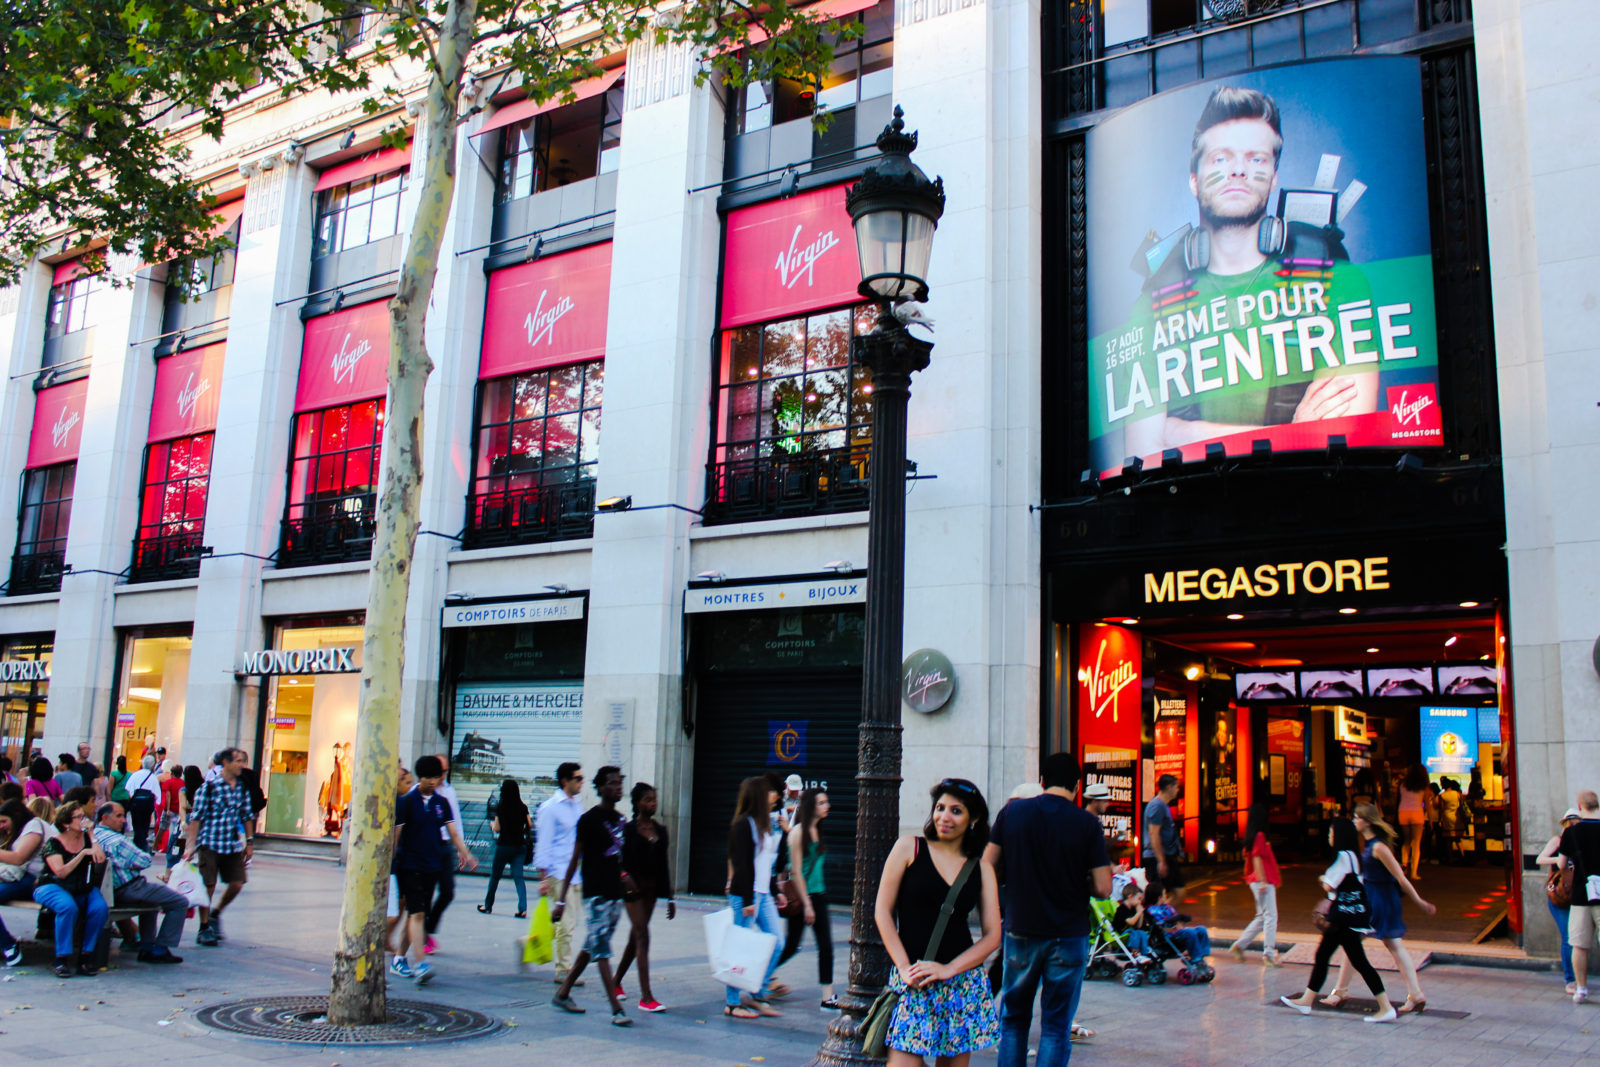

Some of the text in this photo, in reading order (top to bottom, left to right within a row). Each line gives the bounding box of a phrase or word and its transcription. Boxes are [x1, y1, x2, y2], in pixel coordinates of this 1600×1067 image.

[775, 225, 840, 289] Virgin
[524, 290, 574, 346] Virgin
[1153, 282, 1327, 351] ARMÉ POUR
[331, 333, 371, 384] Virgin
[1106, 326, 1144, 355] 17 AOÛT
[1106, 343, 1146, 370] 16 SEPT.
[1105, 299, 1419, 423] LA RENTRÉE
[178, 372, 211, 418] Virgin
[1392, 390, 1433, 426] Virgin
[52, 406, 80, 447] Virgin
[1391, 428, 1441, 439] MEGASTORE
[704, 584, 857, 606] MONTRES BIJOUX
[1144, 557, 1390, 604] MEGASTORE
[456, 607, 526, 622] COMPTOIRS
[543, 605, 568, 616] PARIS
[243, 647, 356, 675] MONOPRIX
[765, 640, 816, 649] COMPTOIRS
[0, 661, 48, 681] OPRIX
[905, 656, 948, 704] Virgin
[1083, 639, 1137, 723] Virgin
[462, 694, 511, 709] BAUME
[1429, 708, 1468, 717] SAMSUNG
